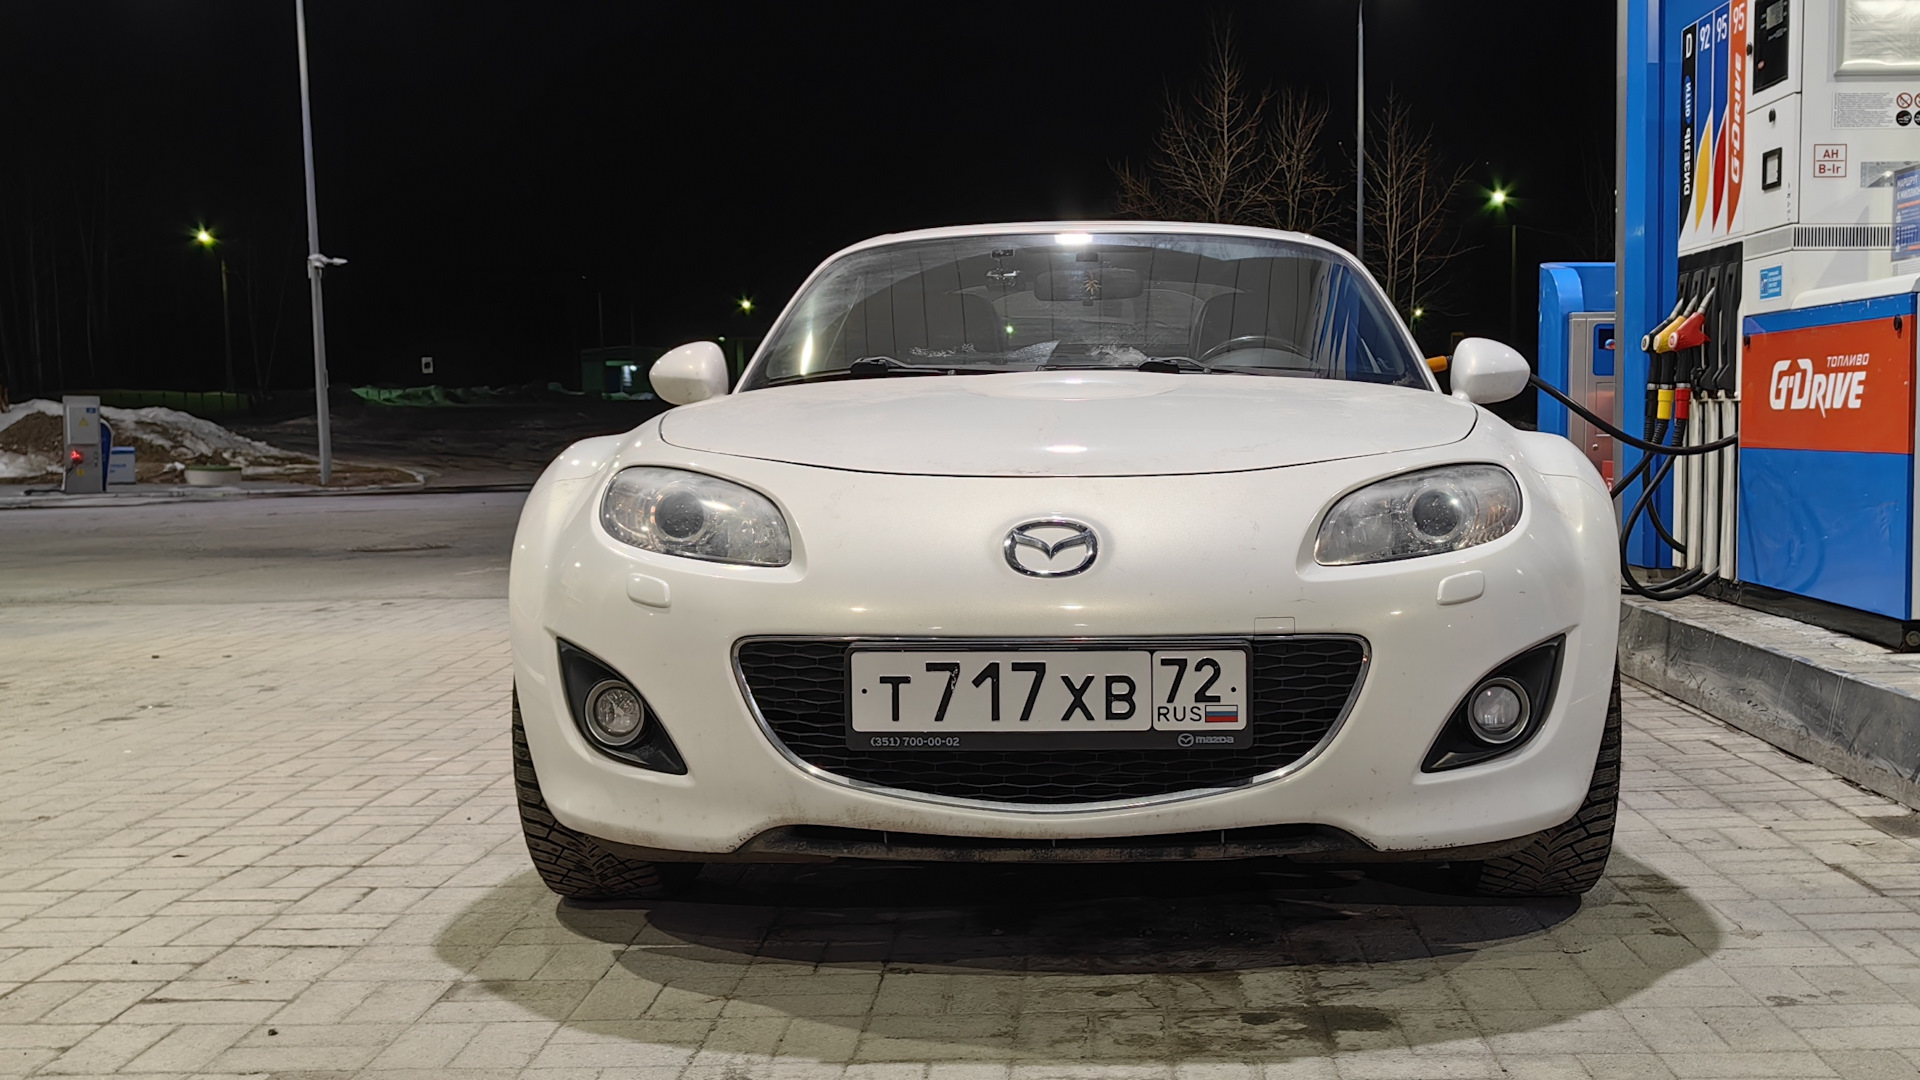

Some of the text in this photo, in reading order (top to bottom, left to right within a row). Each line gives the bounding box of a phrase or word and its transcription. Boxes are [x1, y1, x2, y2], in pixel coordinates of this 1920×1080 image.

[1716, 13, 1728, 43] 95
[1733, 3, 1745, 34] 95
[1685, 33, 1693, 58] D
[1699, 23, 1711, 52] 92
[1826, 353, 1870, 368] ТОПЛИВО
[1160, 658, 1222, 703] 72
[1157, 706, 1203, 722] RUS
[870, 736, 960, 747] (351) 700-00-02
[1195, 735, 1235, 744] mazda
